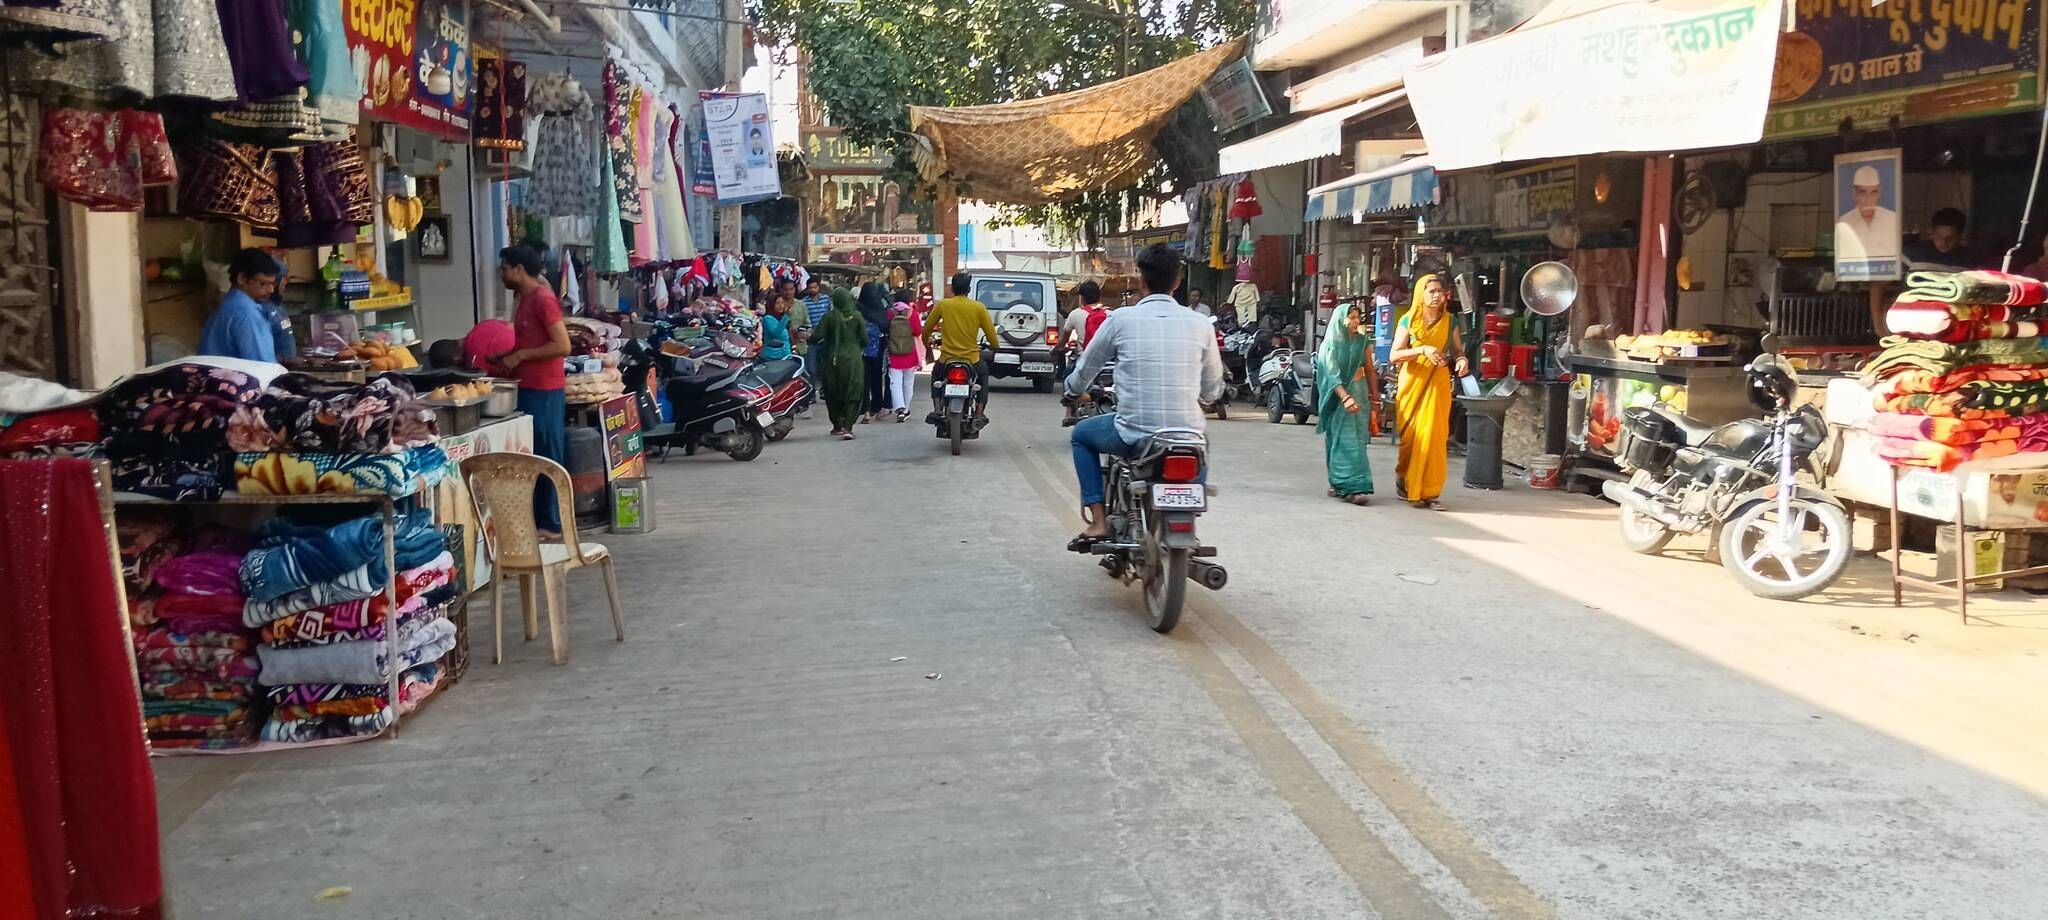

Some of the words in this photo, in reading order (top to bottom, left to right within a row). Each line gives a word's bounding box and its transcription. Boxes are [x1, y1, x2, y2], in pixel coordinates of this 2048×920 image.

[1661, 6, 1757, 77] दुकान
[1828, 62, 1856, 86] 70
[1859, 53, 1902, 80] साल
[1904, 43, 1923, 73] से
[826, 234, 860, 244] TULSI
[863, 234, 920, 244] FASHION
